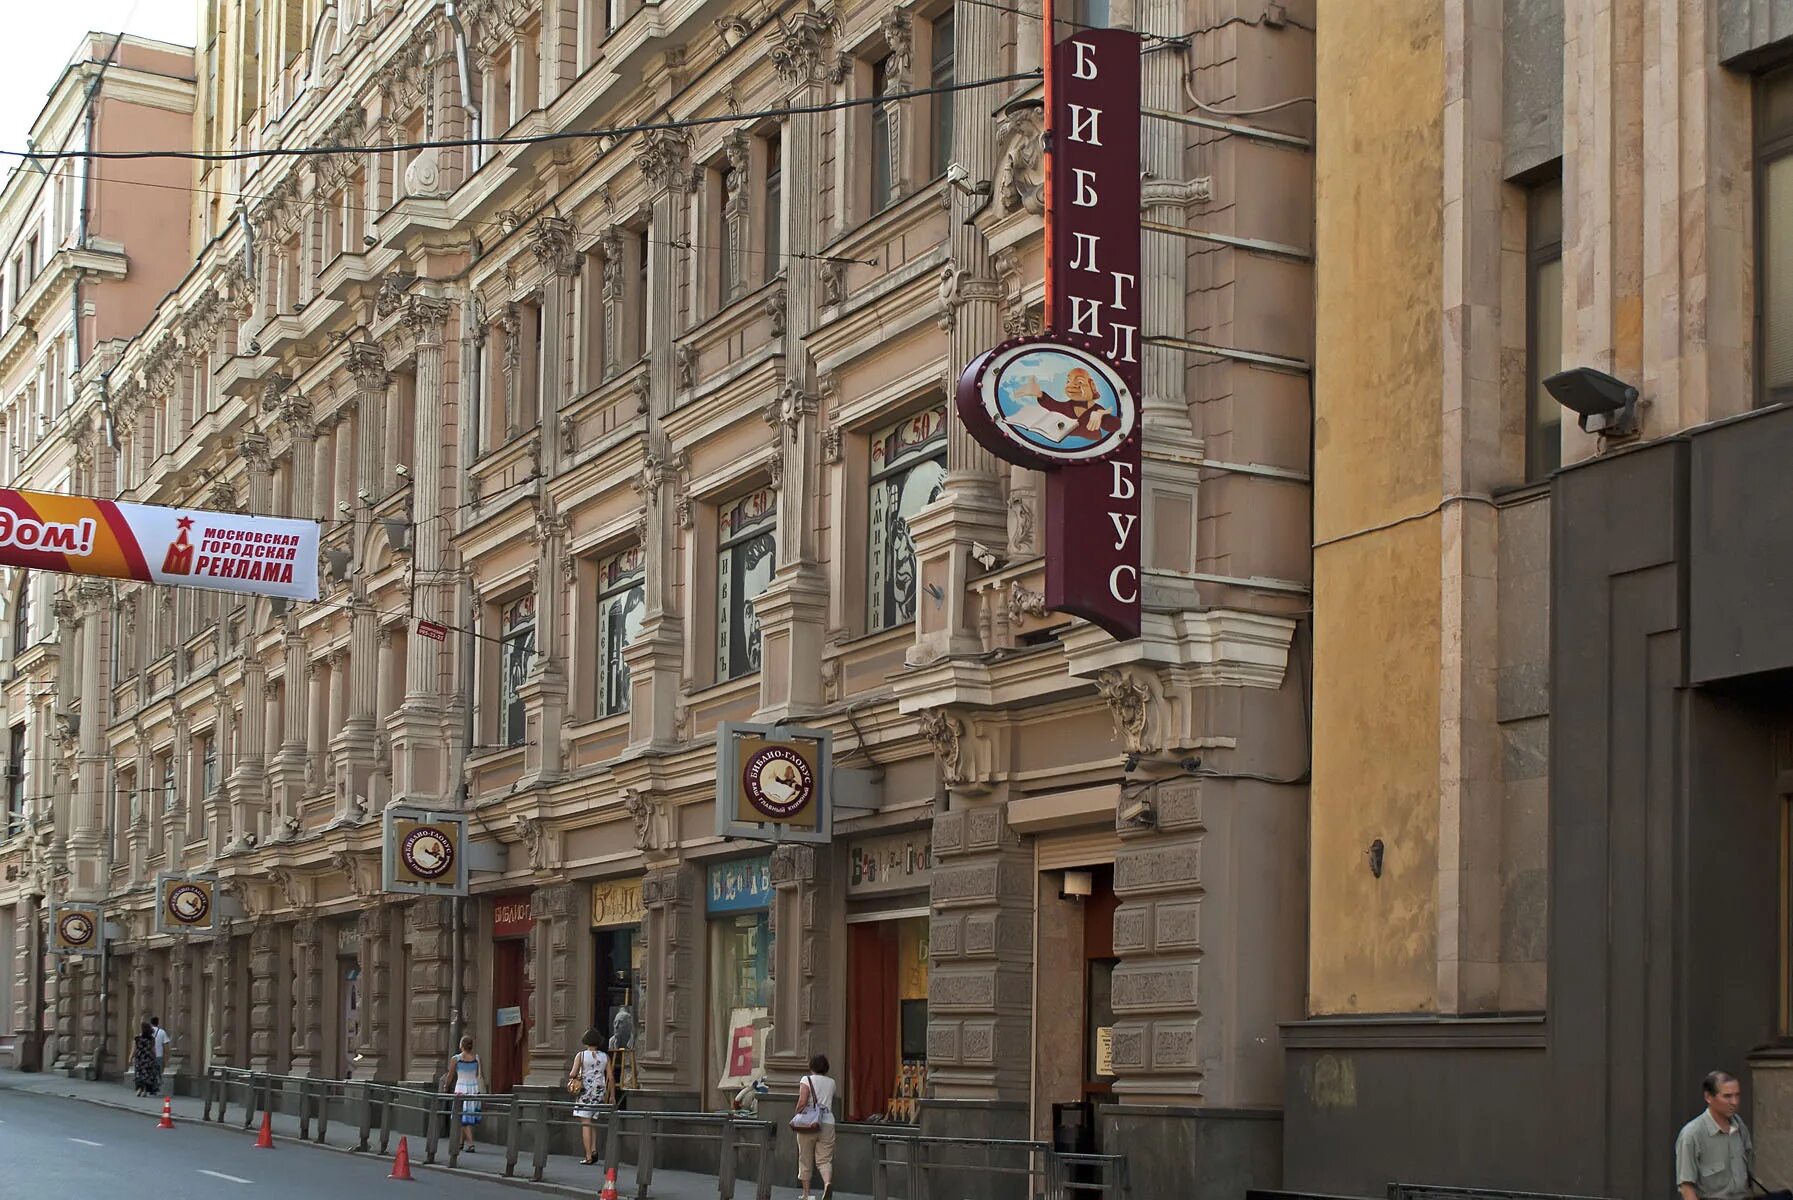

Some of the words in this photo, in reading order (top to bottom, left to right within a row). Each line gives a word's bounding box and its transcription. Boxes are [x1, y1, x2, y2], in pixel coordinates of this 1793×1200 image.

[204, 527, 300, 546] МОСКОВСКАЯ
[201, 540, 297, 560] ГОРОДСКАЯ
[194, 556, 294, 583] РЕКЛАМА
[750, 750, 812, 783] БИБЛИО-ГЛОБУС
